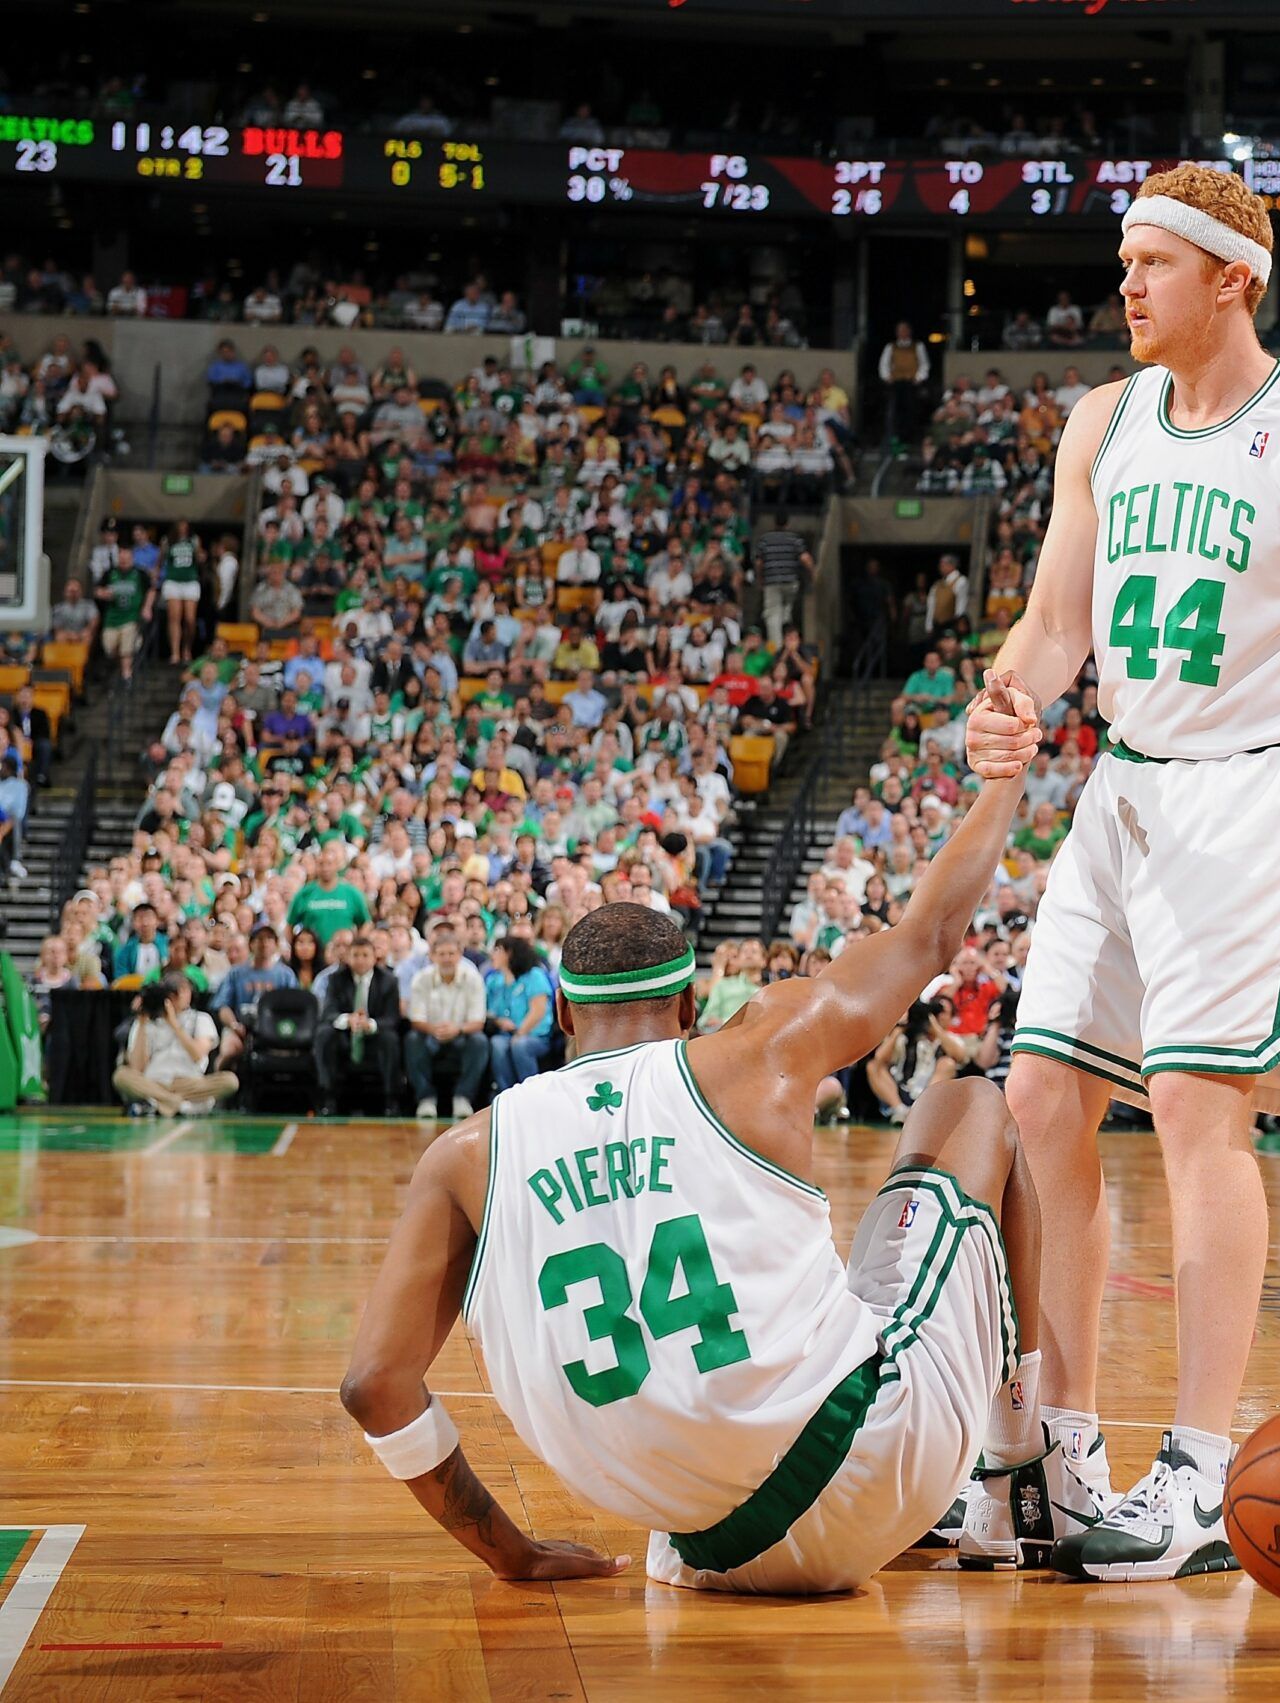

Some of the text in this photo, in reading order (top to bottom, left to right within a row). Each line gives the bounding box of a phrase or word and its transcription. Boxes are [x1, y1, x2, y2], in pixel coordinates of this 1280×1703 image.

[0, 116, 94, 145] ELTICS
[112, 121, 229, 156] 11:42
[242, 127, 342, 159] BULLS
[15, 138, 57, 172] 23
[184, 157, 203, 179] 2
[265, 153, 302, 186] 21
[568, 147, 624, 172] PCT
[710, 154, 748, 178] FG
[834, 161, 886, 184] 3PT
[944, 161, 983, 184] TO
[1022, 161, 1074, 184] STL
[1096, 160, 1152, 183] AST
[948, 189, 970, 215] 4
[1107, 482, 1256, 573] CELTICS
[1108, 575, 1226, 687] 44
[527, 1136, 675, 1225] PIERCE
[538, 1214, 751, 1408] 34
